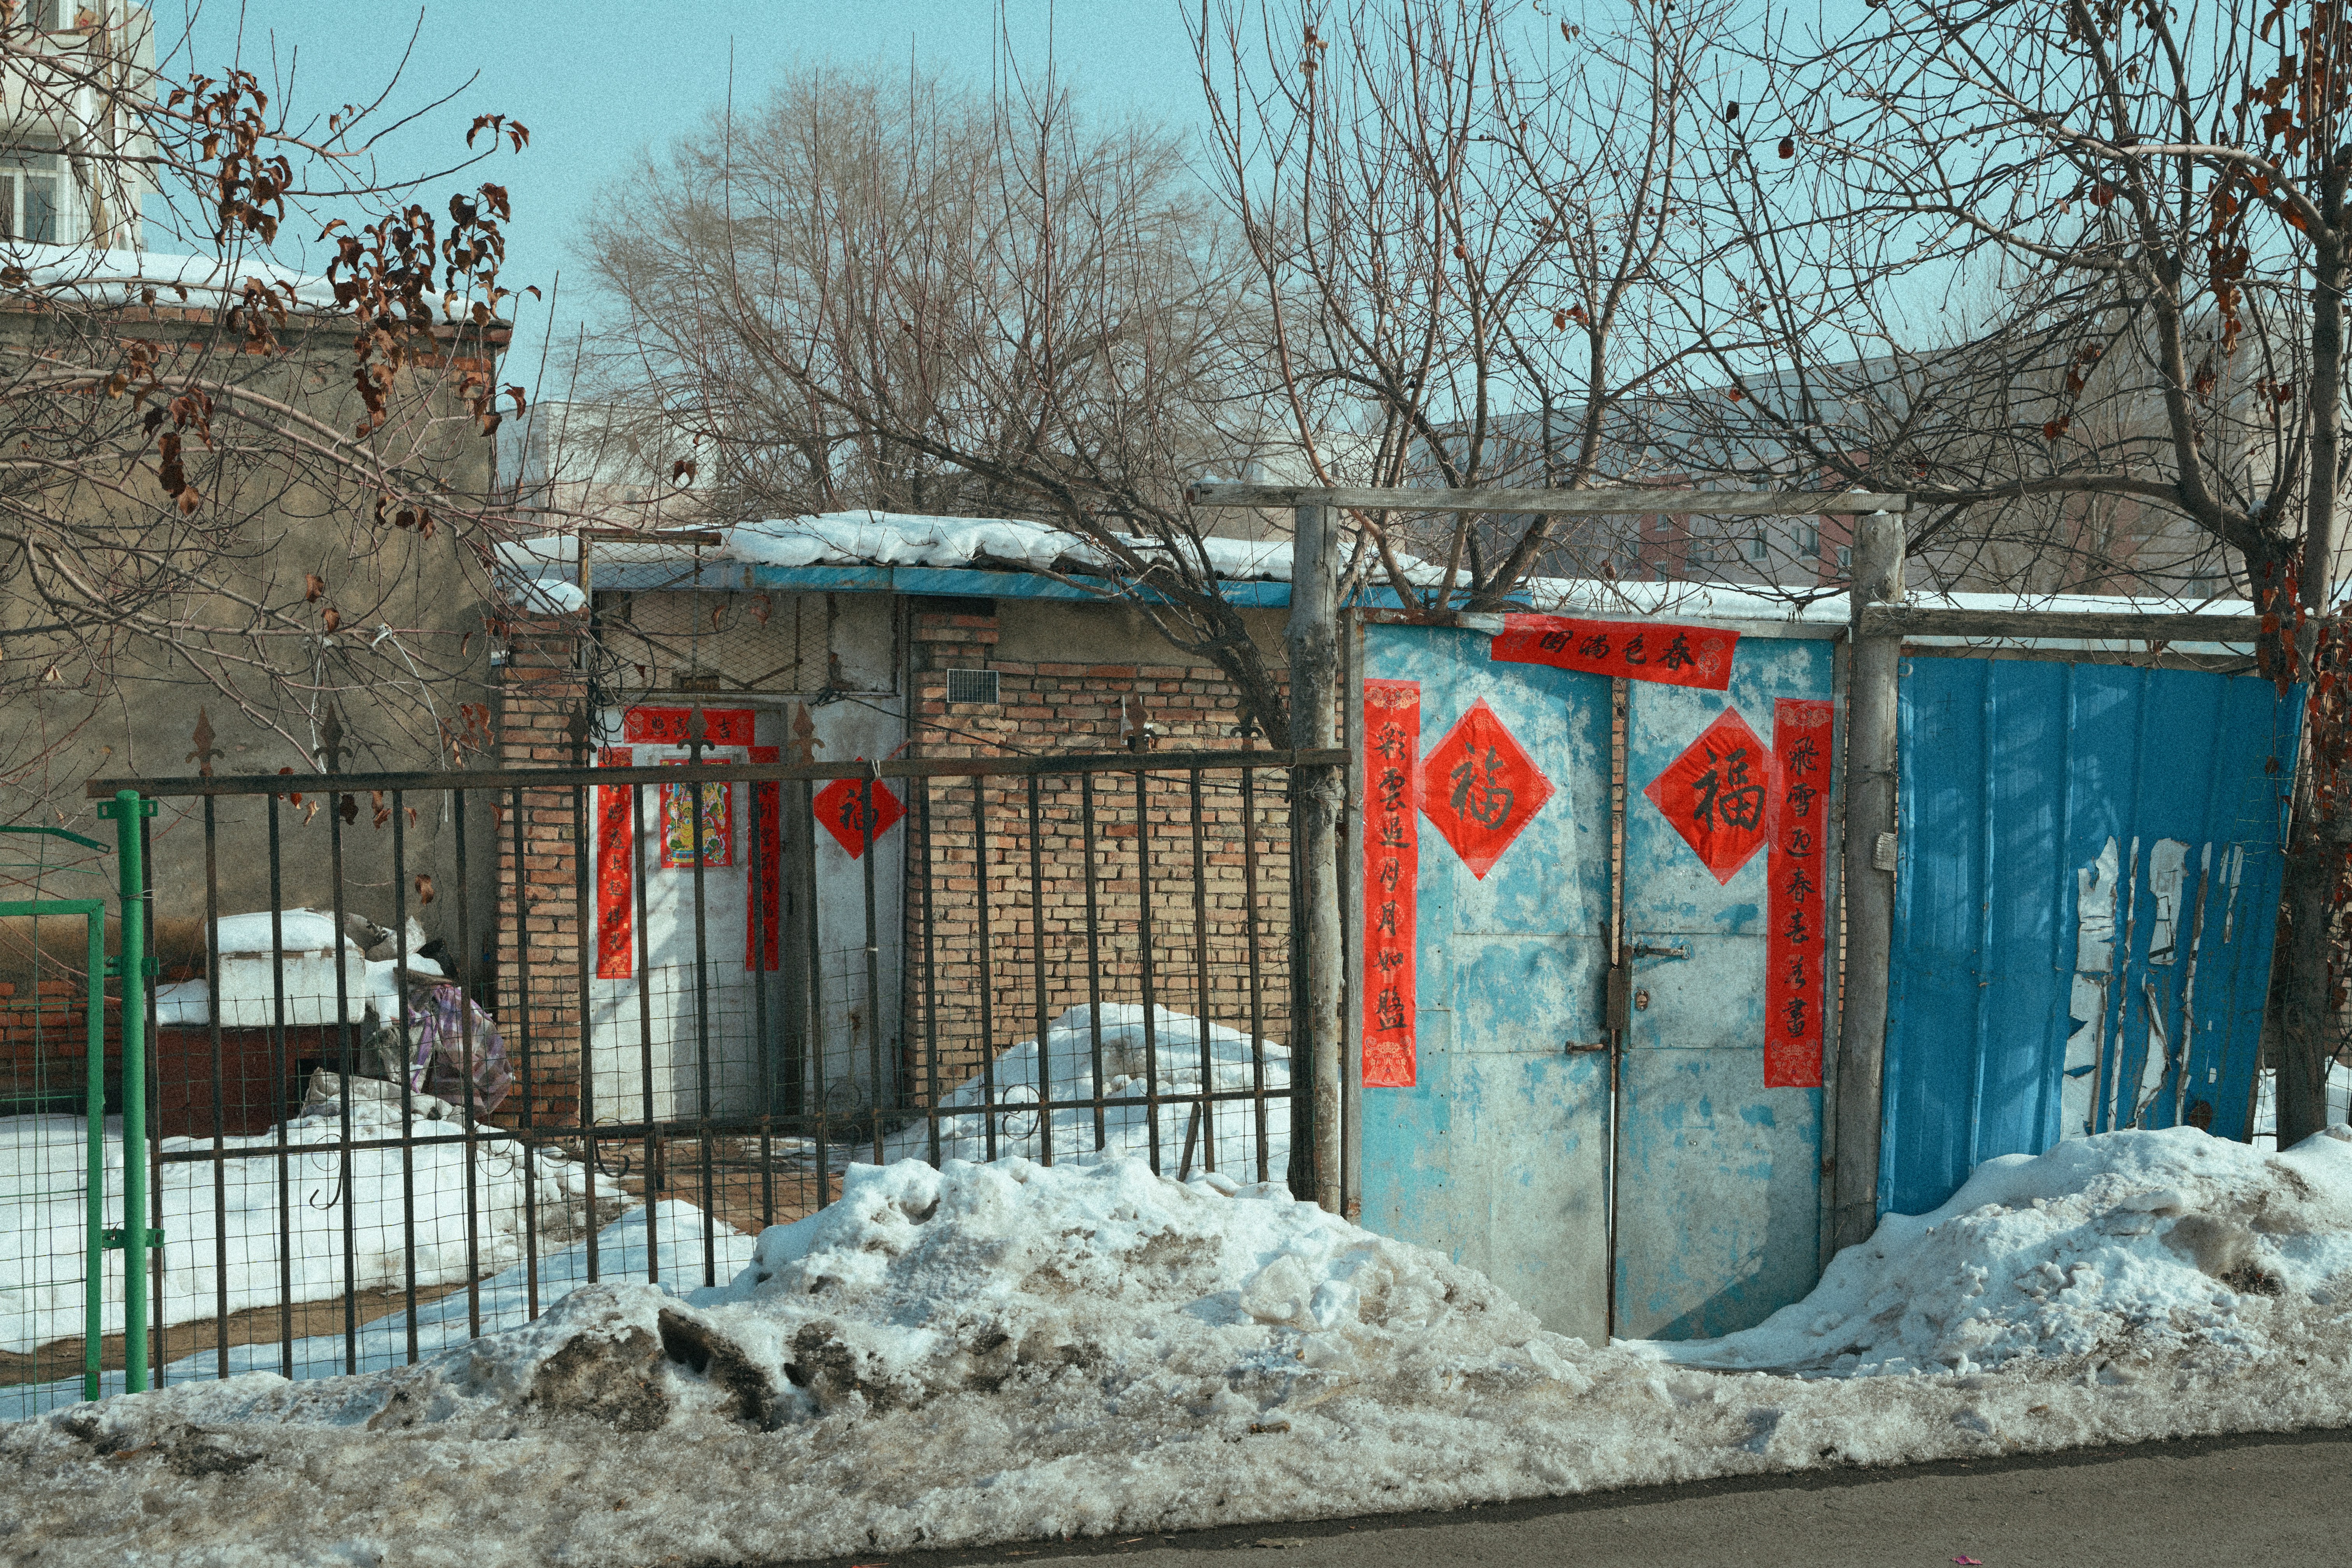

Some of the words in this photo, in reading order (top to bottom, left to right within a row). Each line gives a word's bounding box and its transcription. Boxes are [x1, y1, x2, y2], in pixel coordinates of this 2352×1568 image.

[649, 716, 732, 739] 吉高照
[1450, 742, 1514, 830] 福
[1691, 748, 1765, 832] 福
